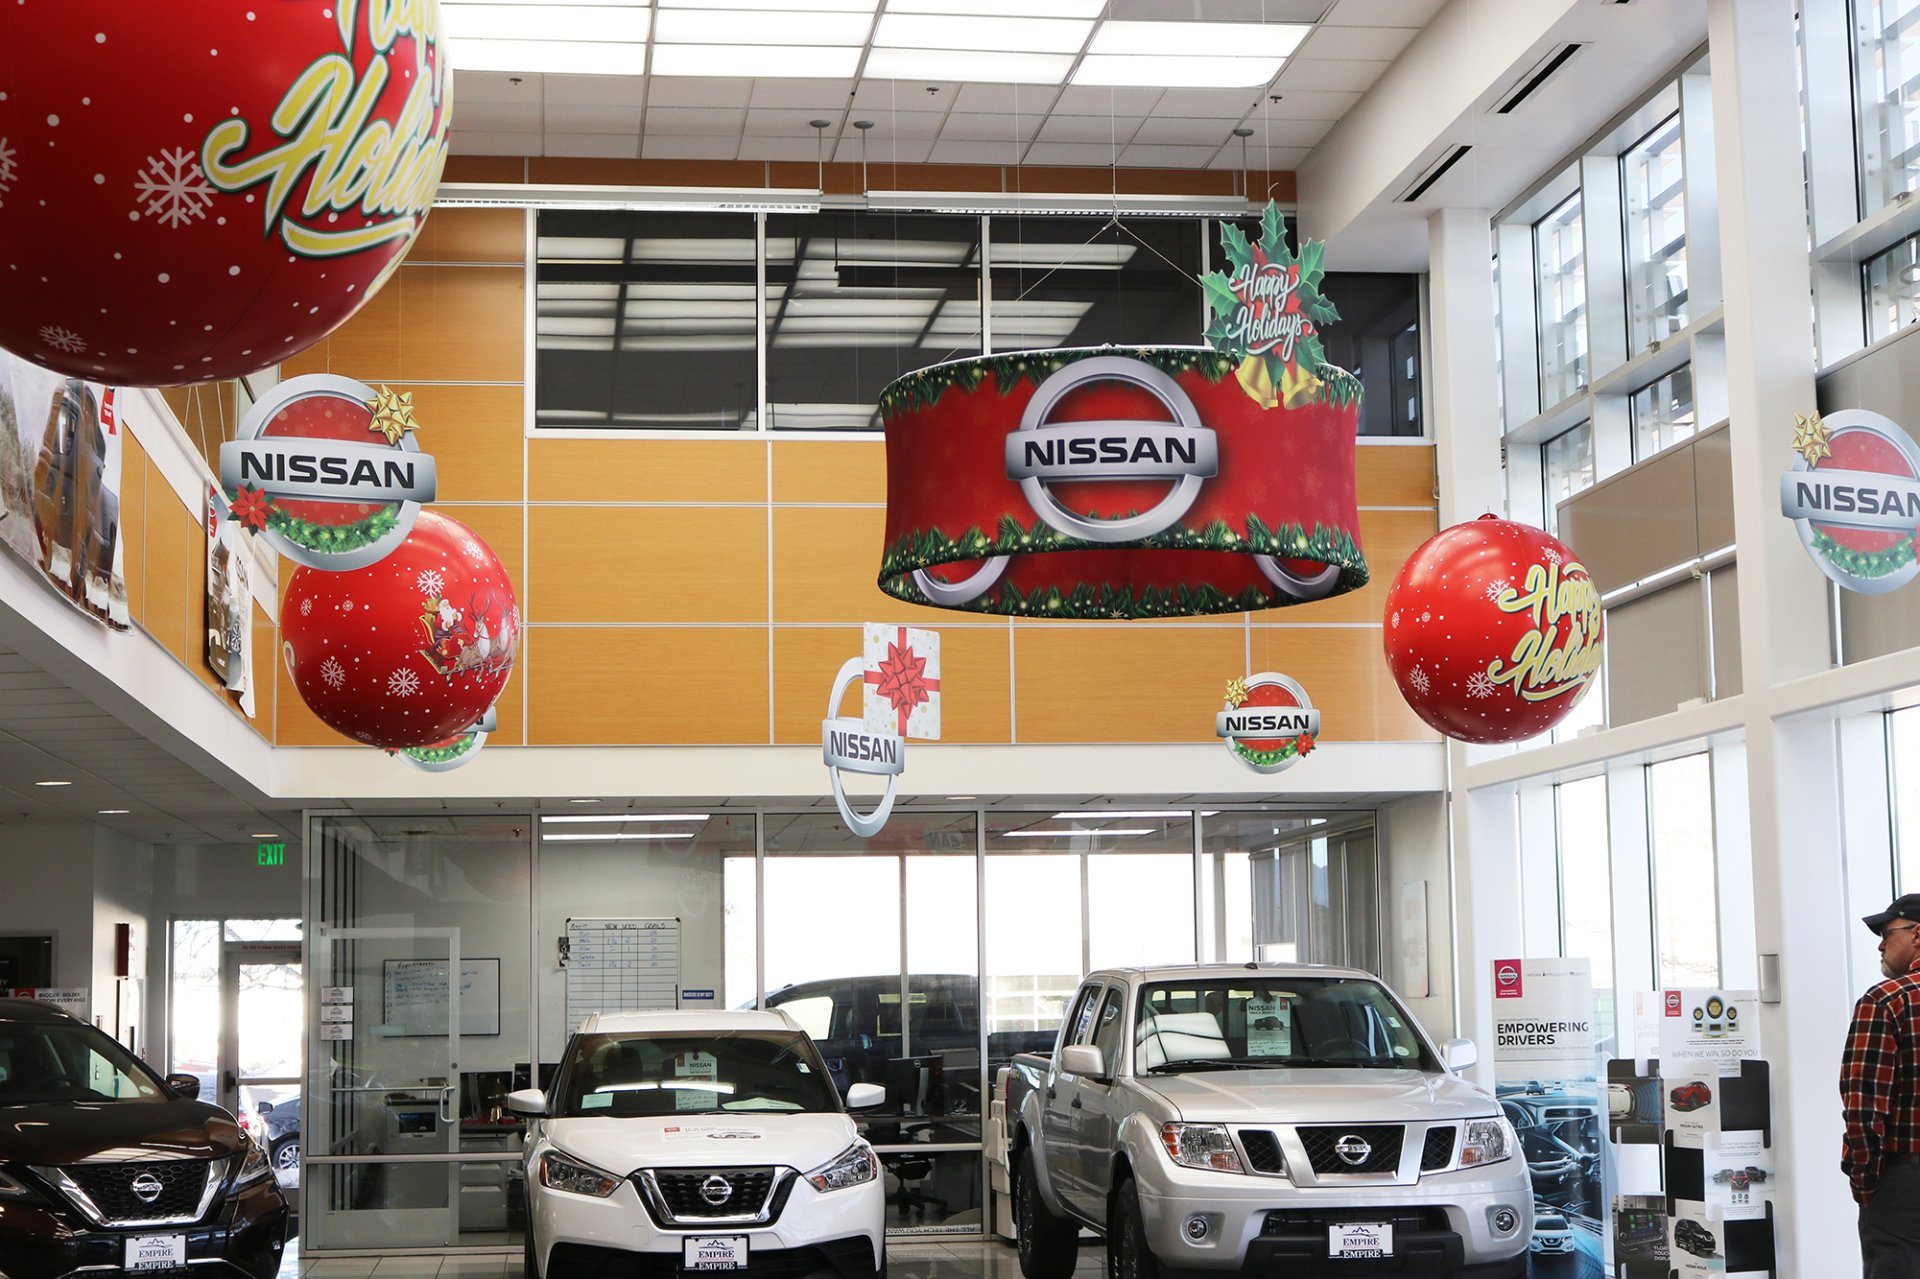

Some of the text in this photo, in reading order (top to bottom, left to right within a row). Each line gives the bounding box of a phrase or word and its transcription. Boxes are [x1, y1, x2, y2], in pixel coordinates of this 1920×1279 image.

[1229, 263, 1300, 312] Happy
[1226, 302, 1313, 362] Holidays
[1024, 436, 1197, 467] NISSAN
[240, 451, 415, 489] NISSAN
[1498, 562, 1600, 640] Happy
[1225, 715, 1309, 731] NISSAN
[830, 730, 896, 764] NISSAN
[257, 844, 285, 865] EXIT
[1497, 1021, 1589, 1034] EMPOWERING
[1498, 1034, 1556, 1046] DRIVERS
[1672, 1050, 1693, 1058] WHEN
[1694, 1050, 1705, 1058] WE
[1720, 1049, 1731, 1057] SO
[1732, 1049, 1742, 1057] DO
[1744, 1049, 1758, 1057] YOU
[689, 1061, 712, 1069] NISSAN
[1343, 1238, 1380, 1246] EMPIRE
[139, 1248, 174, 1258] EMPIRE
[698, 1250, 735, 1258] EMPIRE
[1343, 1250, 1381, 1259] EMPIRE
[138, 1260, 174, 1271] EMPIRE
[698, 1262, 736, 1271] EMPIRE
